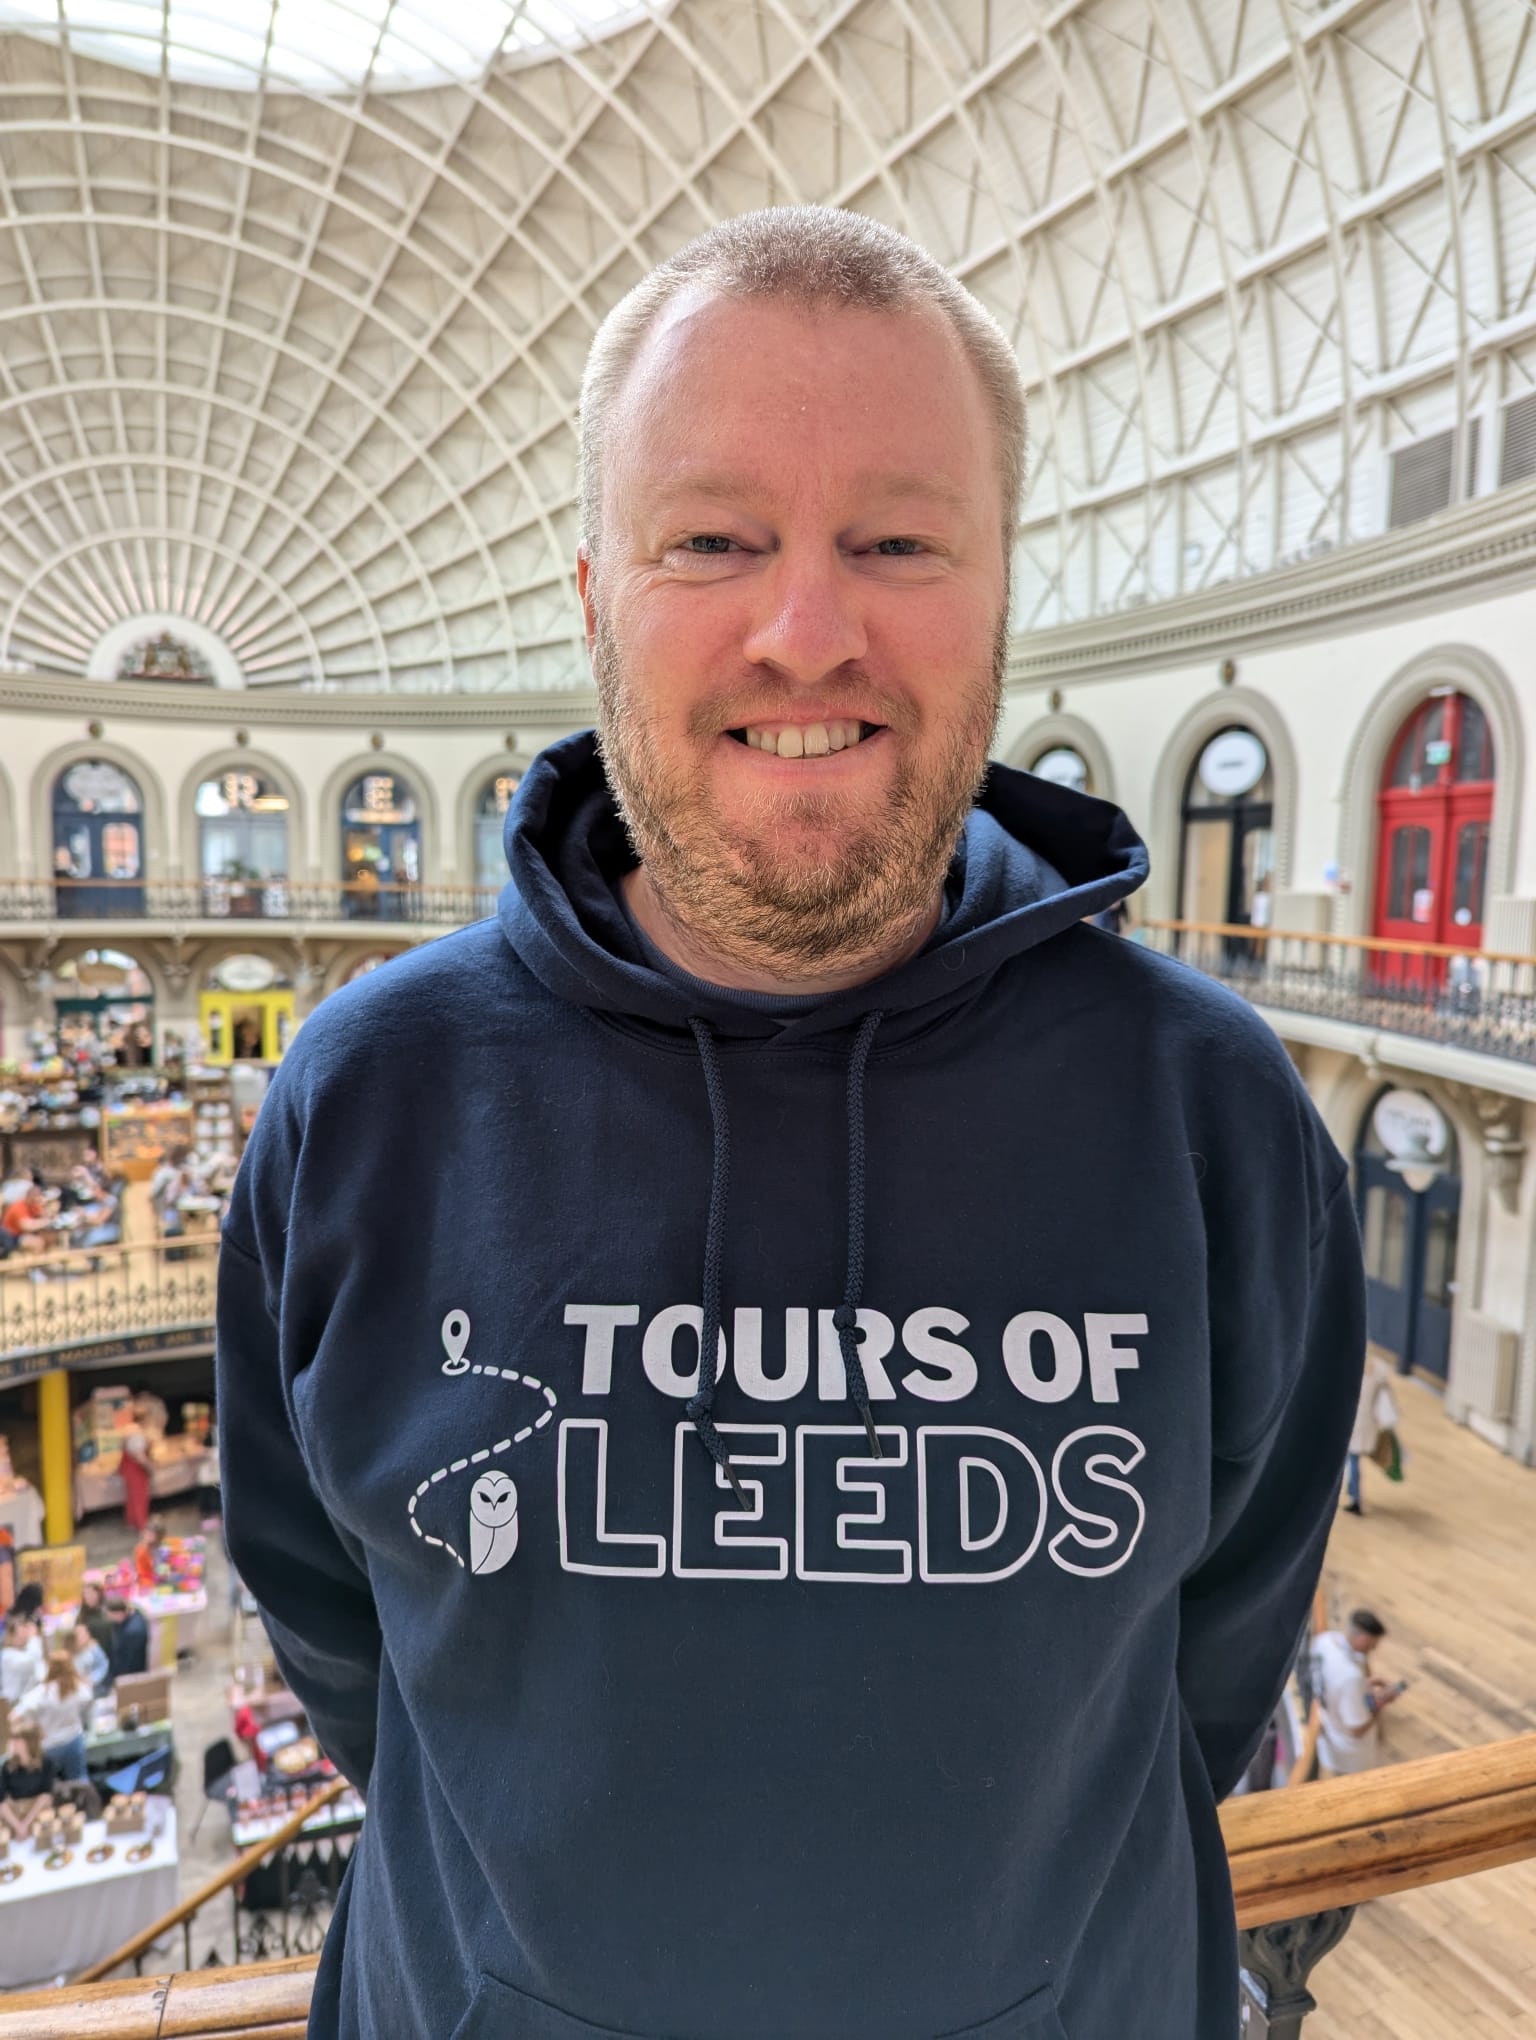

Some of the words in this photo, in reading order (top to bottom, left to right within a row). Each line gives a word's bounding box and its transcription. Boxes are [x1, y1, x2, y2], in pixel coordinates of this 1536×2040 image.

[563, 1304, 978, 1402] TOURS
[1002, 1310, 1149, 1403] OF
[556, 1418, 1147, 1584] LEEDS
